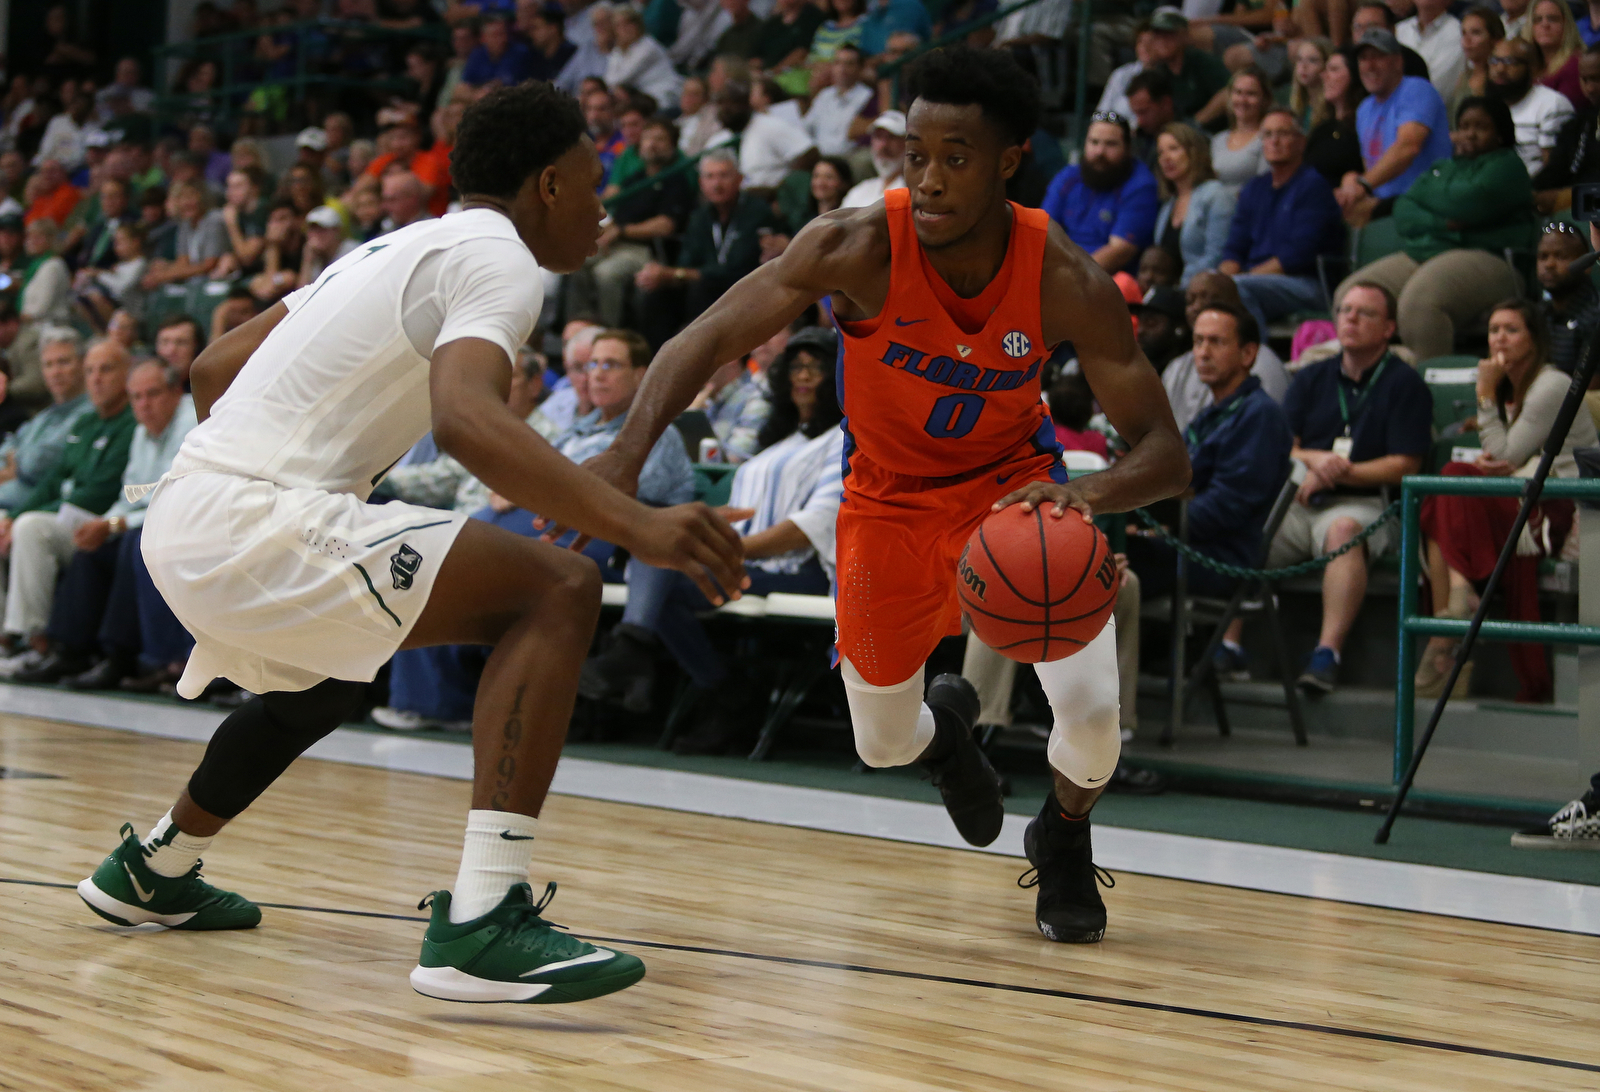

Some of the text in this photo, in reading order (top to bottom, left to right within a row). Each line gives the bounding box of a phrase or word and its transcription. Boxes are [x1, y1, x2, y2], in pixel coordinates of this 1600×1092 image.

[878, 340, 1043, 391] FLORIDA
[1002, 330, 1031, 358] SEC
[923, 393, 987, 439] 0
